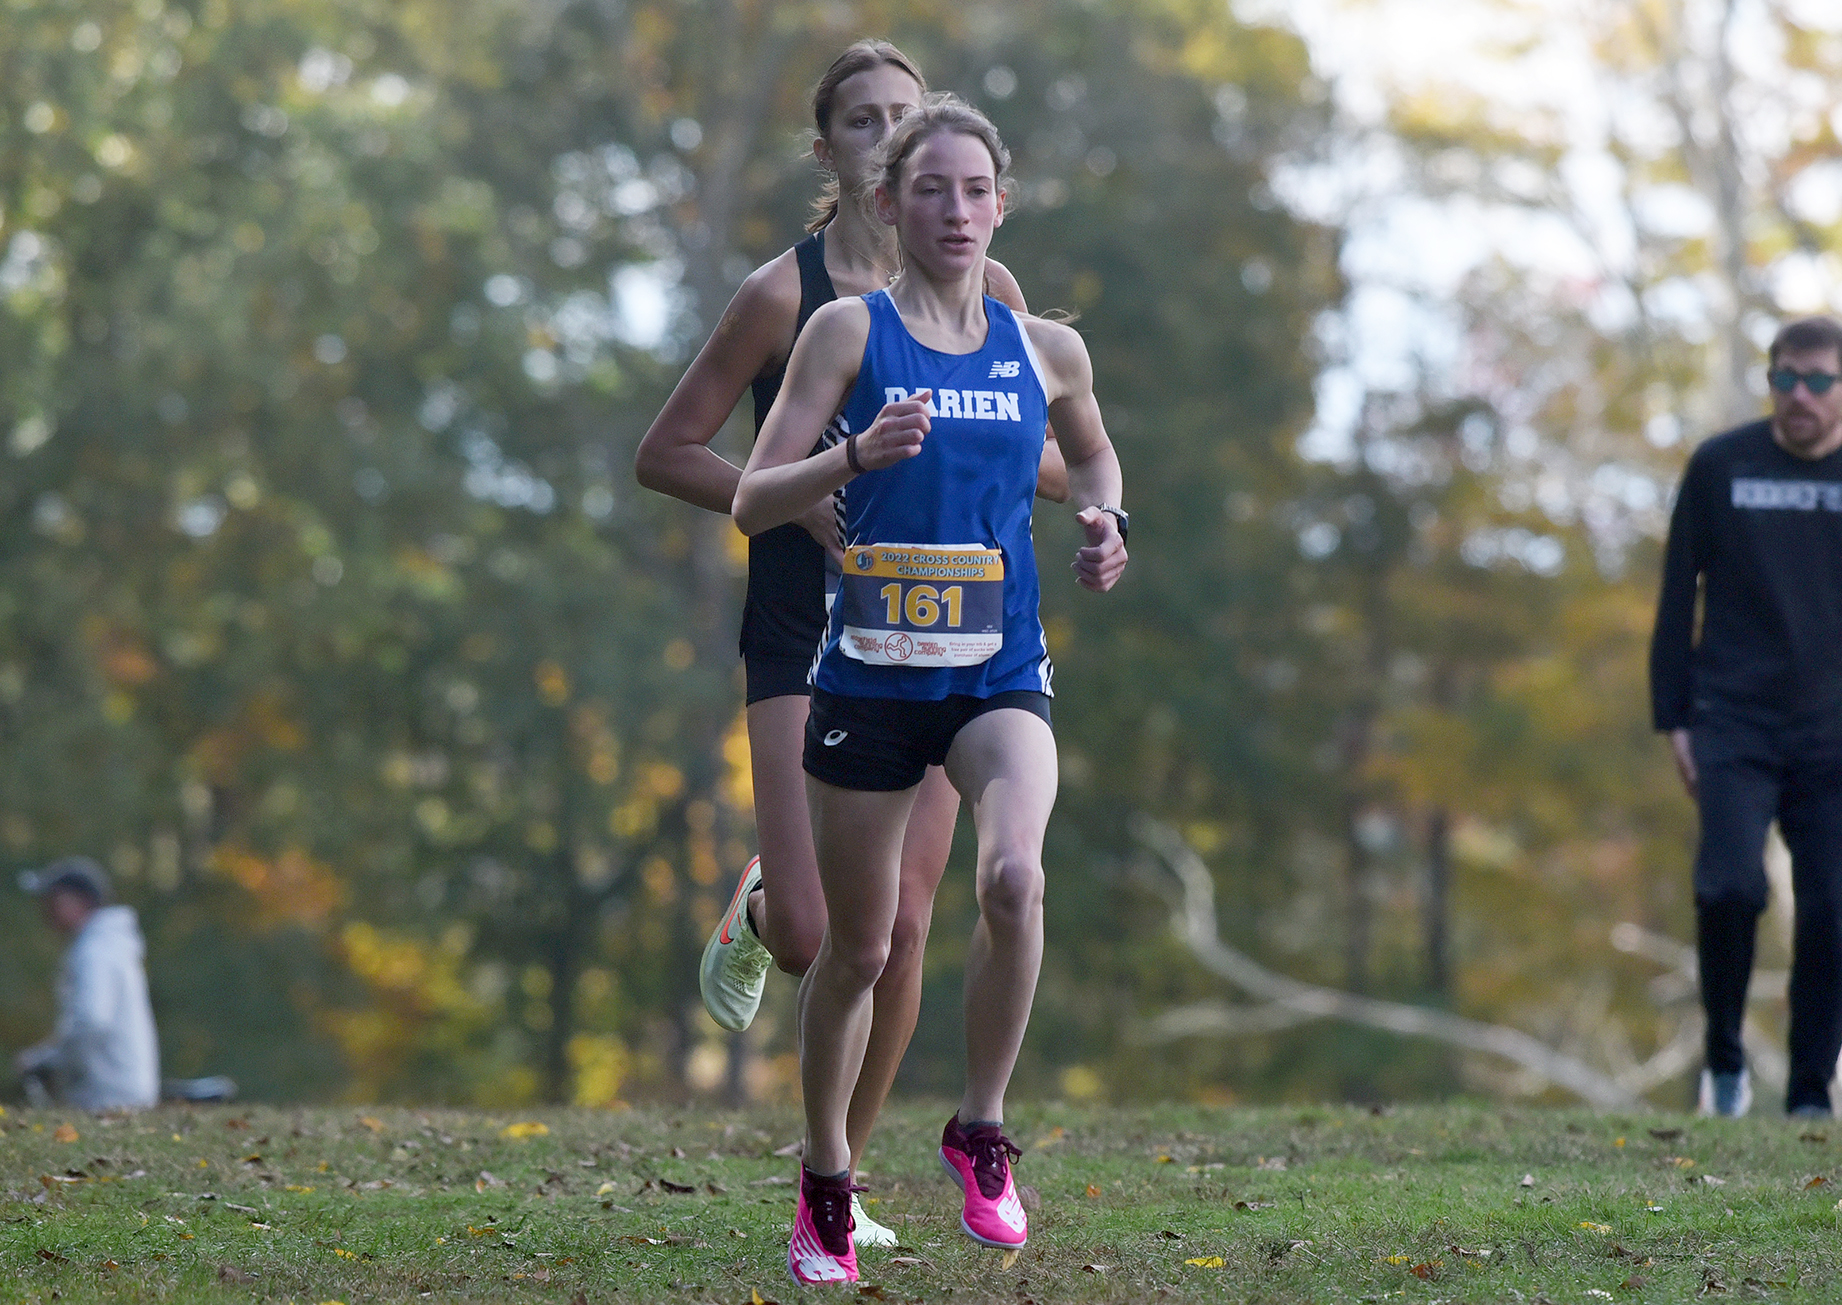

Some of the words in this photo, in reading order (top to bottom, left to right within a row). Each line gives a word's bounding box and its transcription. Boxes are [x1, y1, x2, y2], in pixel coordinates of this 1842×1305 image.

[881, 551, 910, 563] 2022
[912, 554, 949, 565] CROSS
[951, 555, 1000, 566] COUNTRY
[896, 565, 985, 578] CHAMPIONSHIPS
[880, 583, 963, 628] 161
